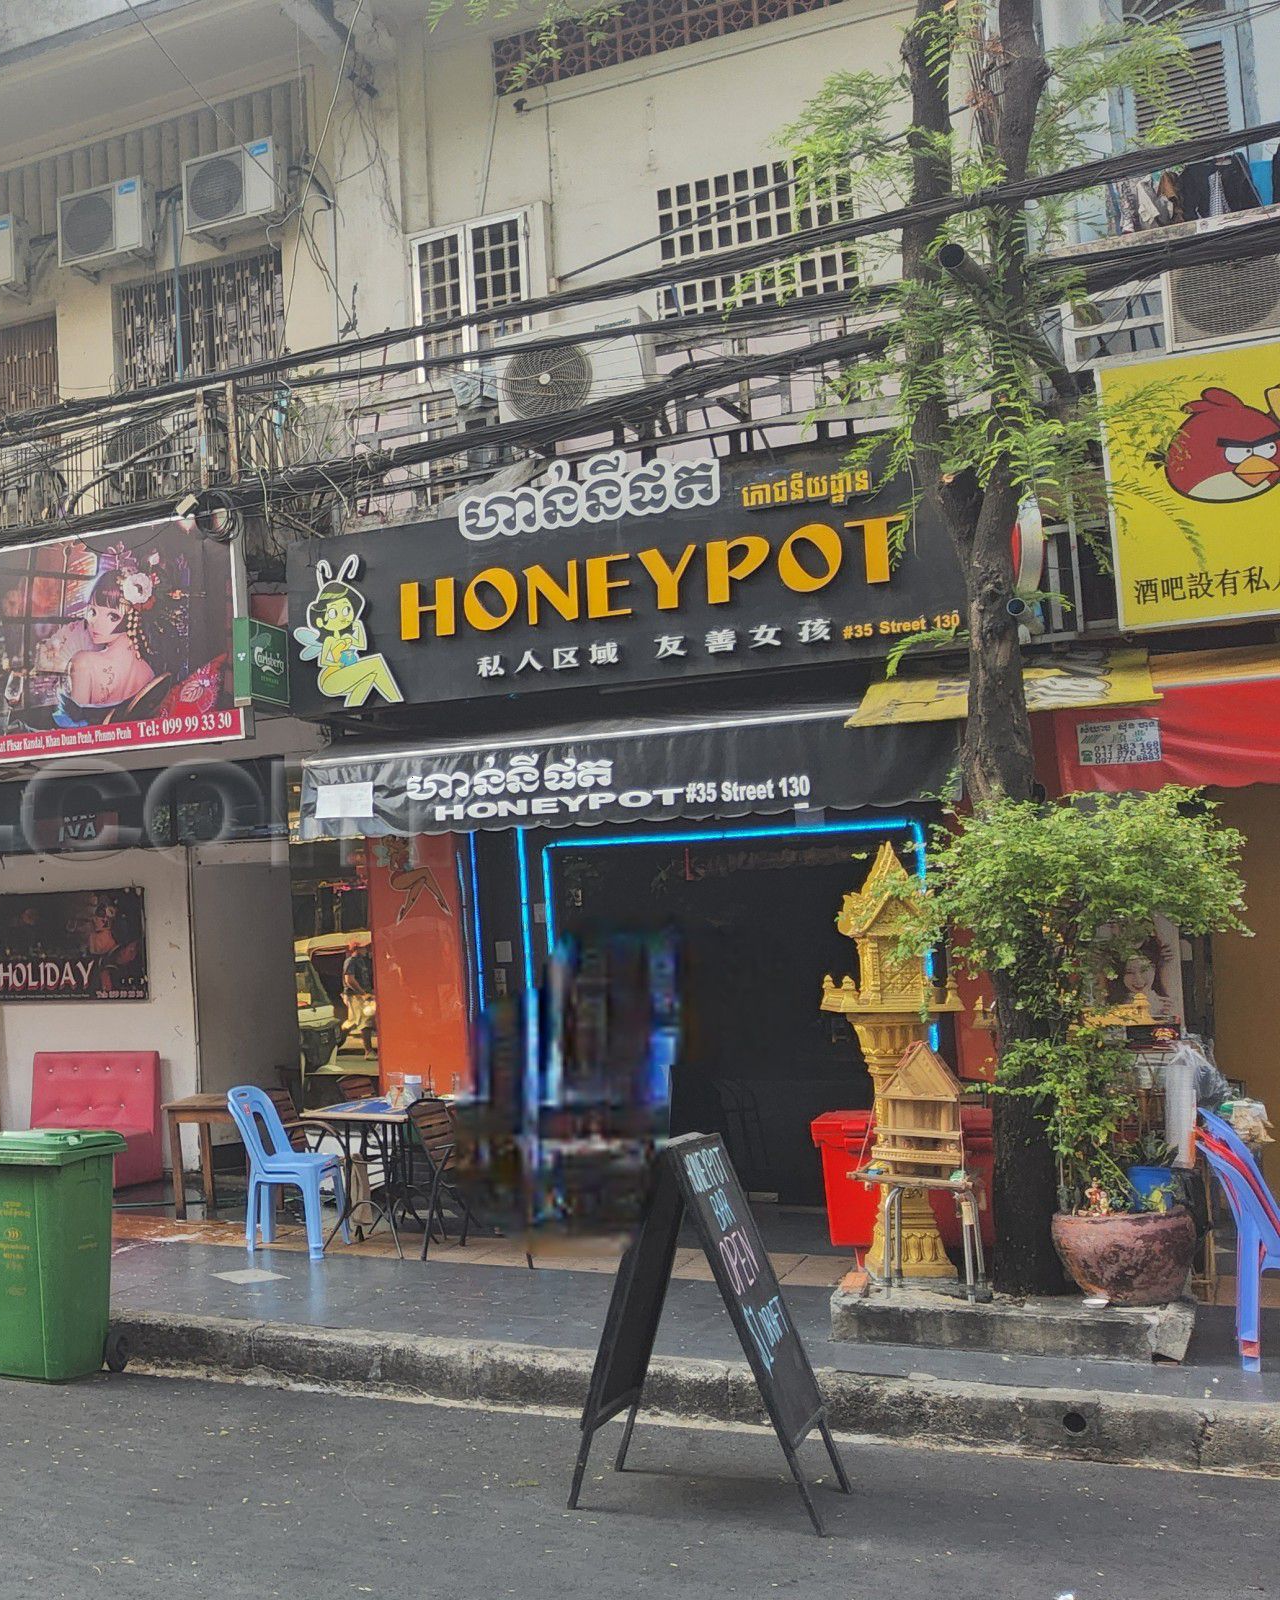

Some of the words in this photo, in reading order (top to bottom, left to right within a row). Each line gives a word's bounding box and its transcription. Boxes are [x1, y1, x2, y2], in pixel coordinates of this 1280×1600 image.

[400, 514, 907, 641] HONEYPOT
[1133, 564, 1280, 606] 酒吧設有私
[476, 640, 621, 679] 私人区域
[653, 617, 833, 660] 友善女孩
[842, 624, 874, 640] #35
[878, 616, 927, 635] Street
[932, 613, 961, 630] 130
[254, 646, 285, 675] Carlsberg
[137, 720, 160, 738] Tel:
[162, 717, 182, 735] 099
[184, 716, 199, 733] 99
[201, 713, 216, 731] 33
[217, 711, 232, 729] 30
[435, 786, 684, 822] HONEYPOT
[686, 787, 717, 803] #35
[721, 780, 775, 802] Street
[778, 775, 811, 798] 130
[684, 1146, 729, 1195] HONEYPOT
[709, 1188, 736, 1232] BAR
[719, 1225, 760, 1296] OPEN
